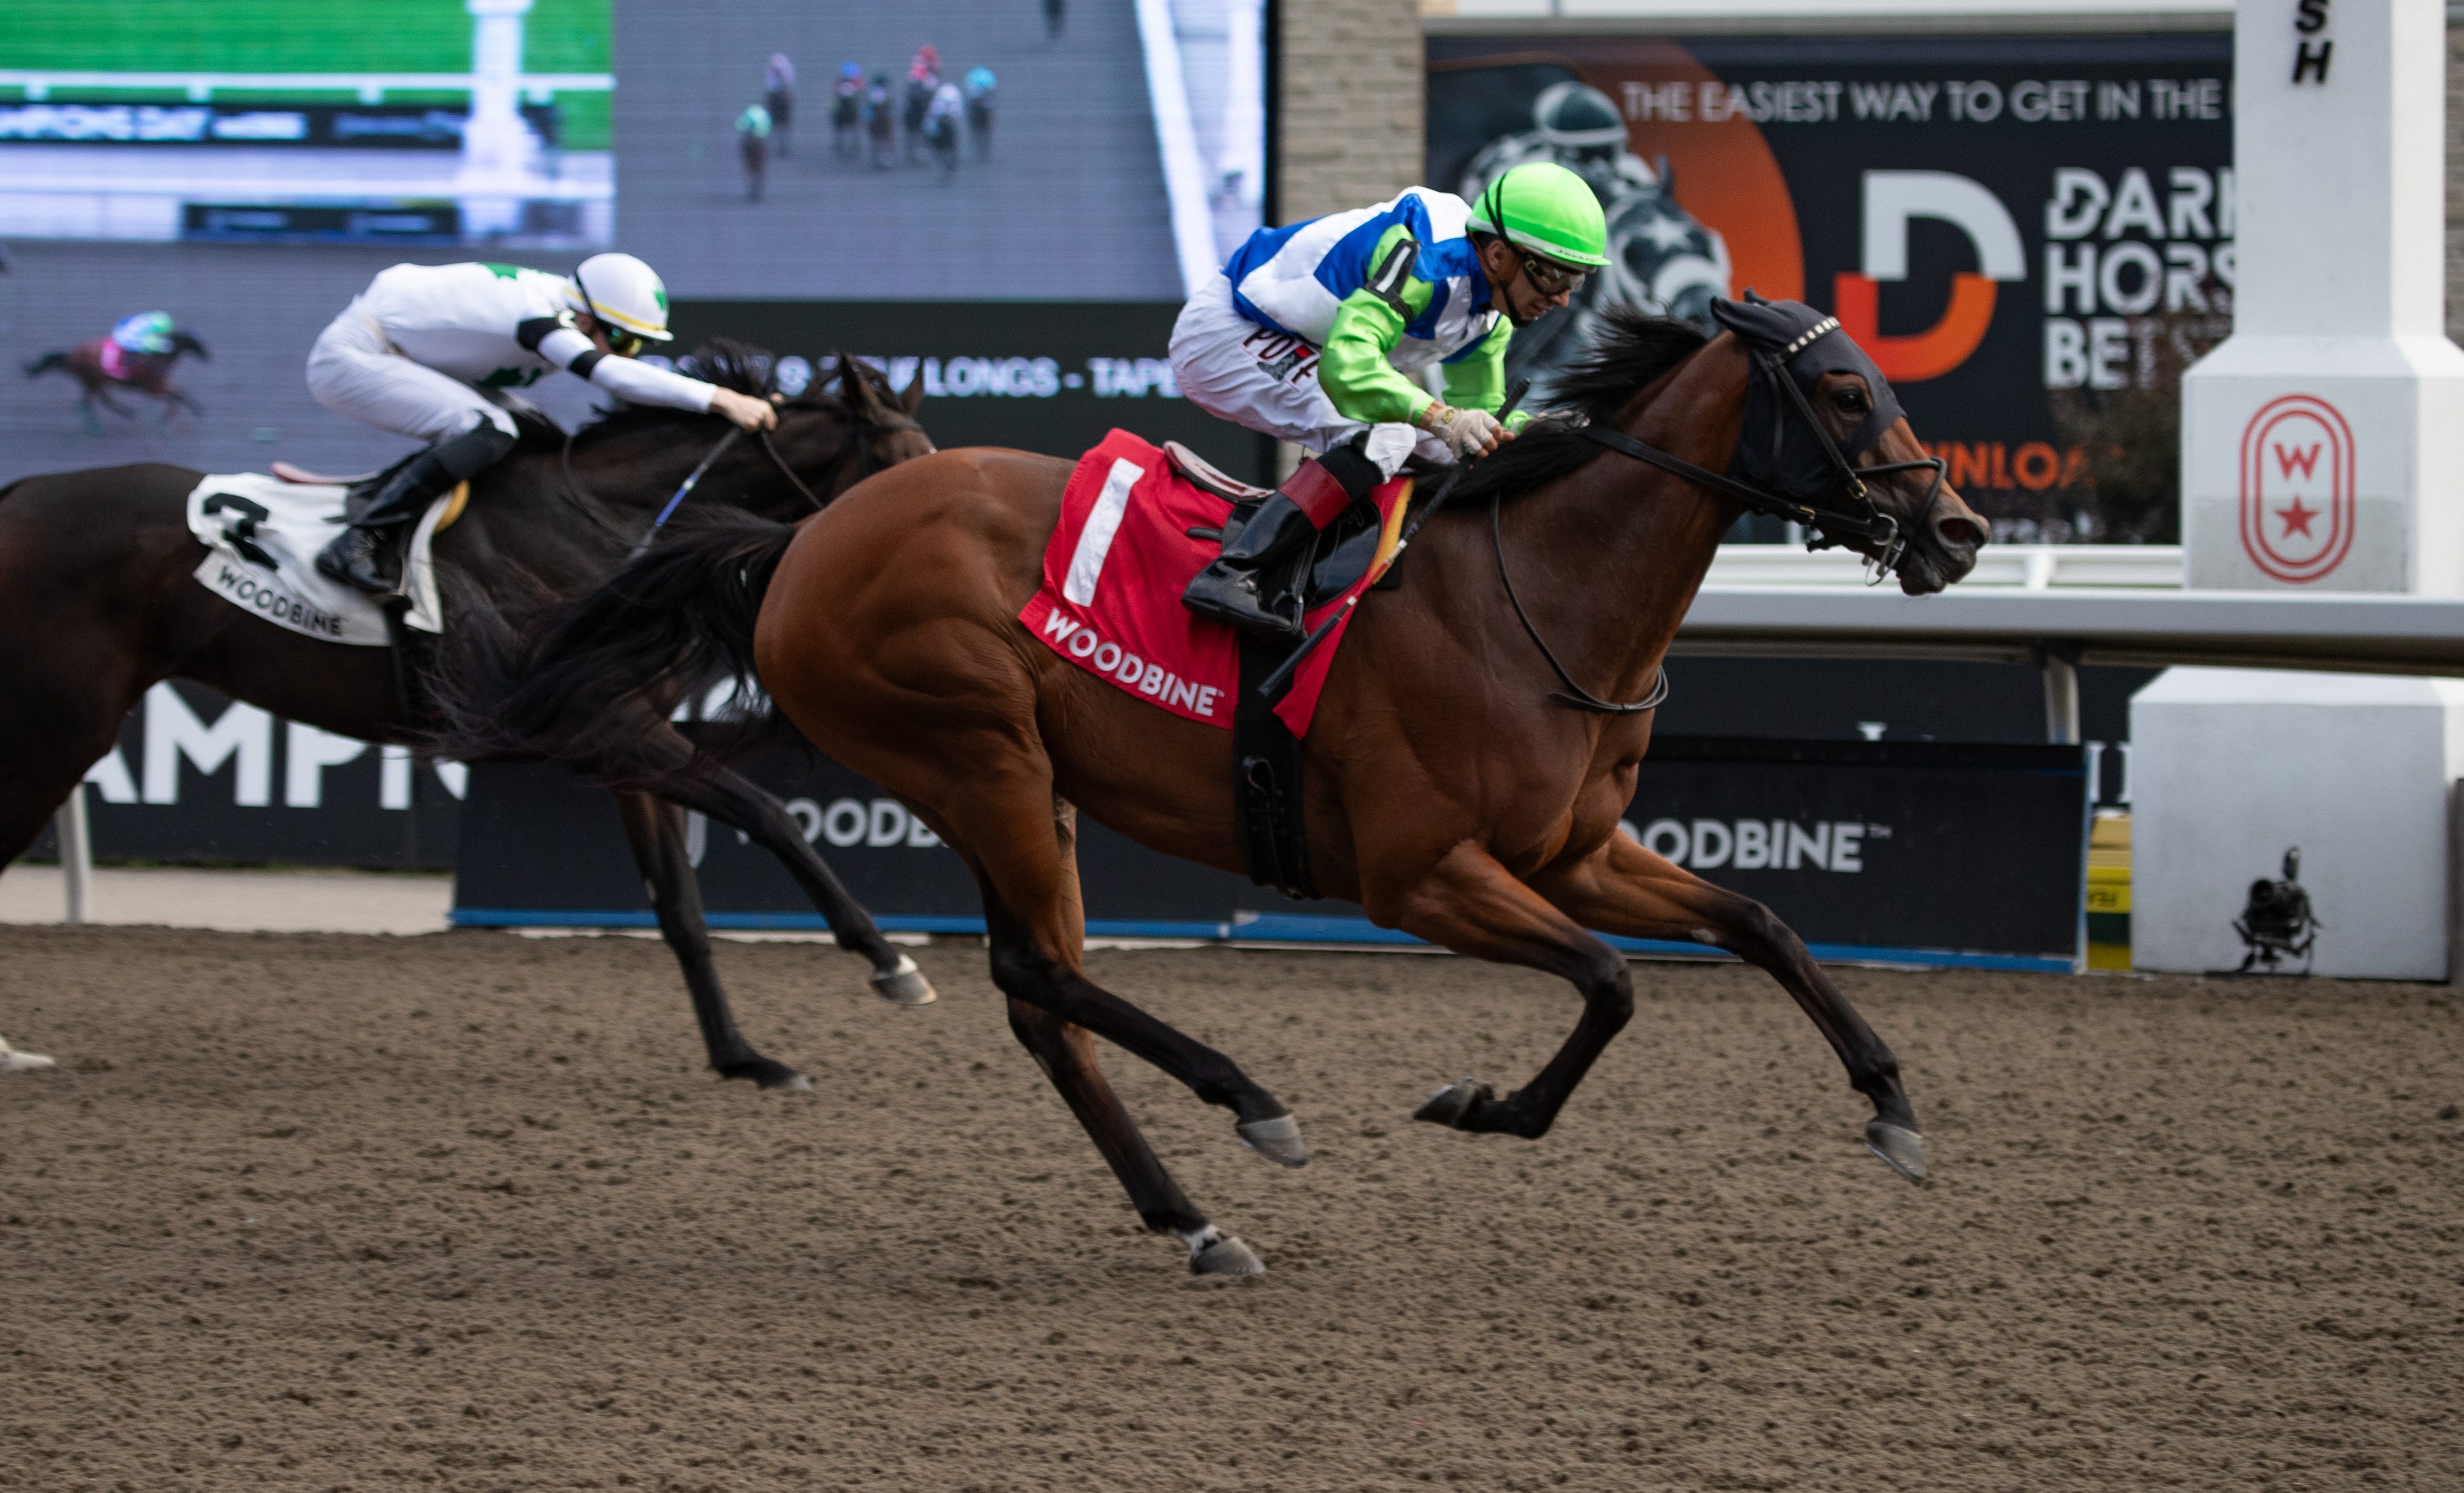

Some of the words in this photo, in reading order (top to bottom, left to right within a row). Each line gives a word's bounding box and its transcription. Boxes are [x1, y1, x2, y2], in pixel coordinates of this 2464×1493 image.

[1623, 80, 1690, 122] THE
[1698, 80, 1844, 122] EASIEST
[1850, 81, 1939, 122] WAY
[1945, 80, 2003, 122] TO
[2009, 80, 2090, 122] GET
[2097, 79, 2140, 121] IN
[2147, 79, 2222, 120] THE
[2273, 442, 2323, 480] W
[1063, 457, 1145, 607] 1
[218, 565, 341, 636] WOODBINE
